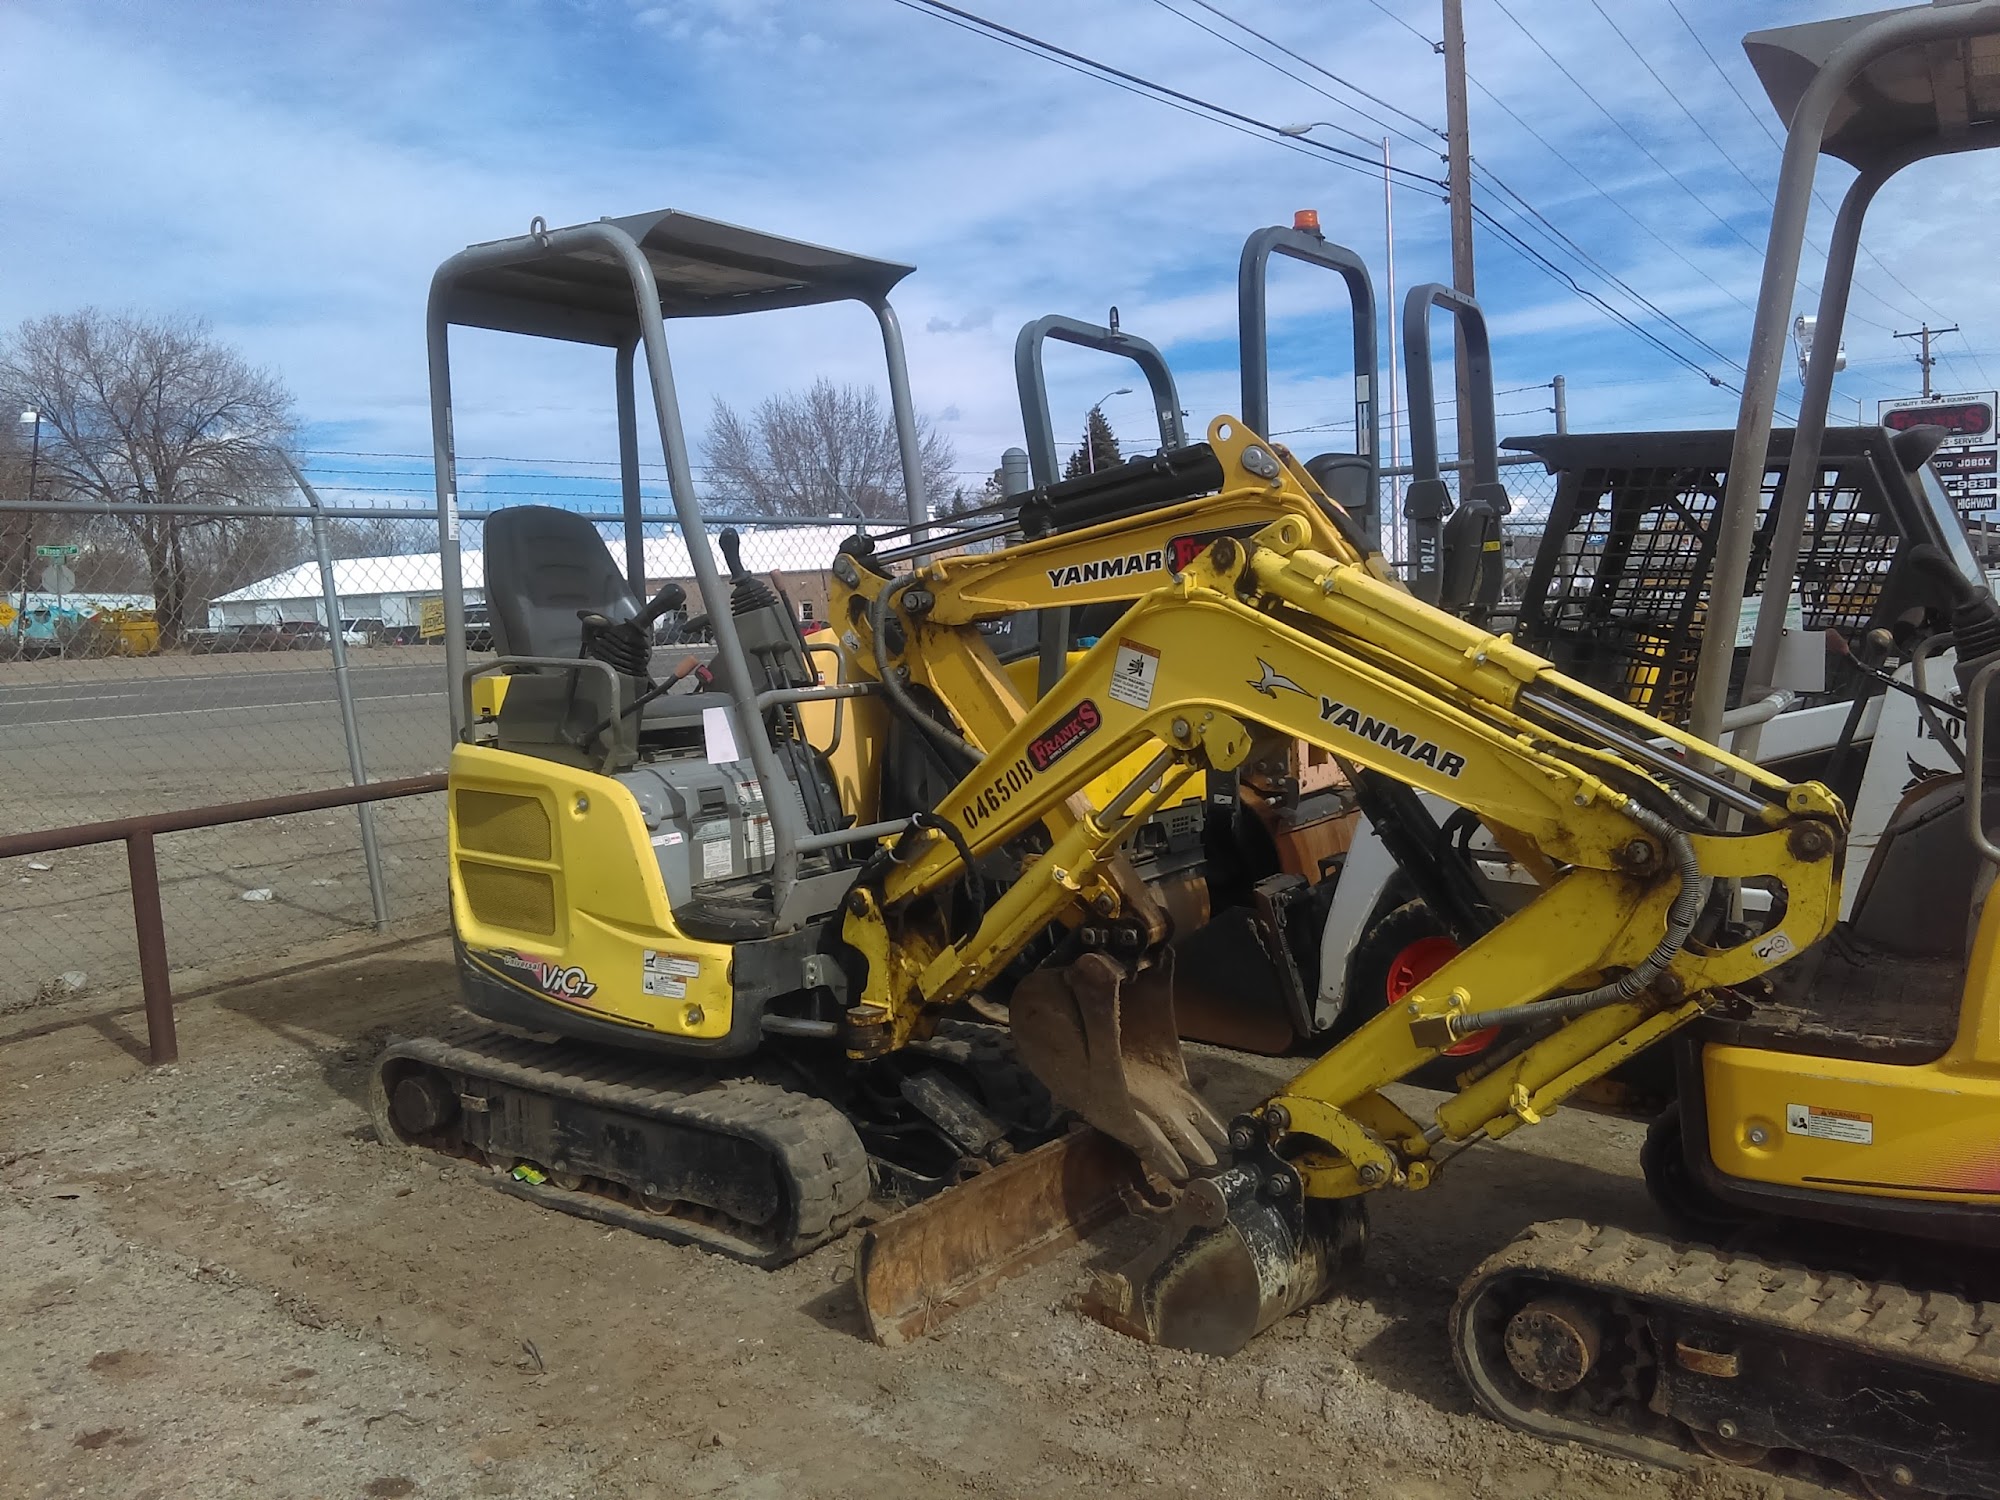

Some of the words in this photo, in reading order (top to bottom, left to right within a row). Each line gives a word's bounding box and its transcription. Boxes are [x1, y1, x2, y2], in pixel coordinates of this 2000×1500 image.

[1947, 395, 1979, 403] EQUIPMENT
[1954, 437, 1983, 445] SERVICE
[1958, 458, 1991, 468] JOBOX
[1957, 497, 1993, 509] HIGHWAY
[1420, 537, 1435, 573] 7784
[1047, 550, 1163, 588] YANMAR
[1030, 703, 1098, 767] FRANK'S
[1320, 696, 1466, 778] YANMAR
[963, 759, 1033, 829] 04650B
[504, 955, 540, 971] Universal
